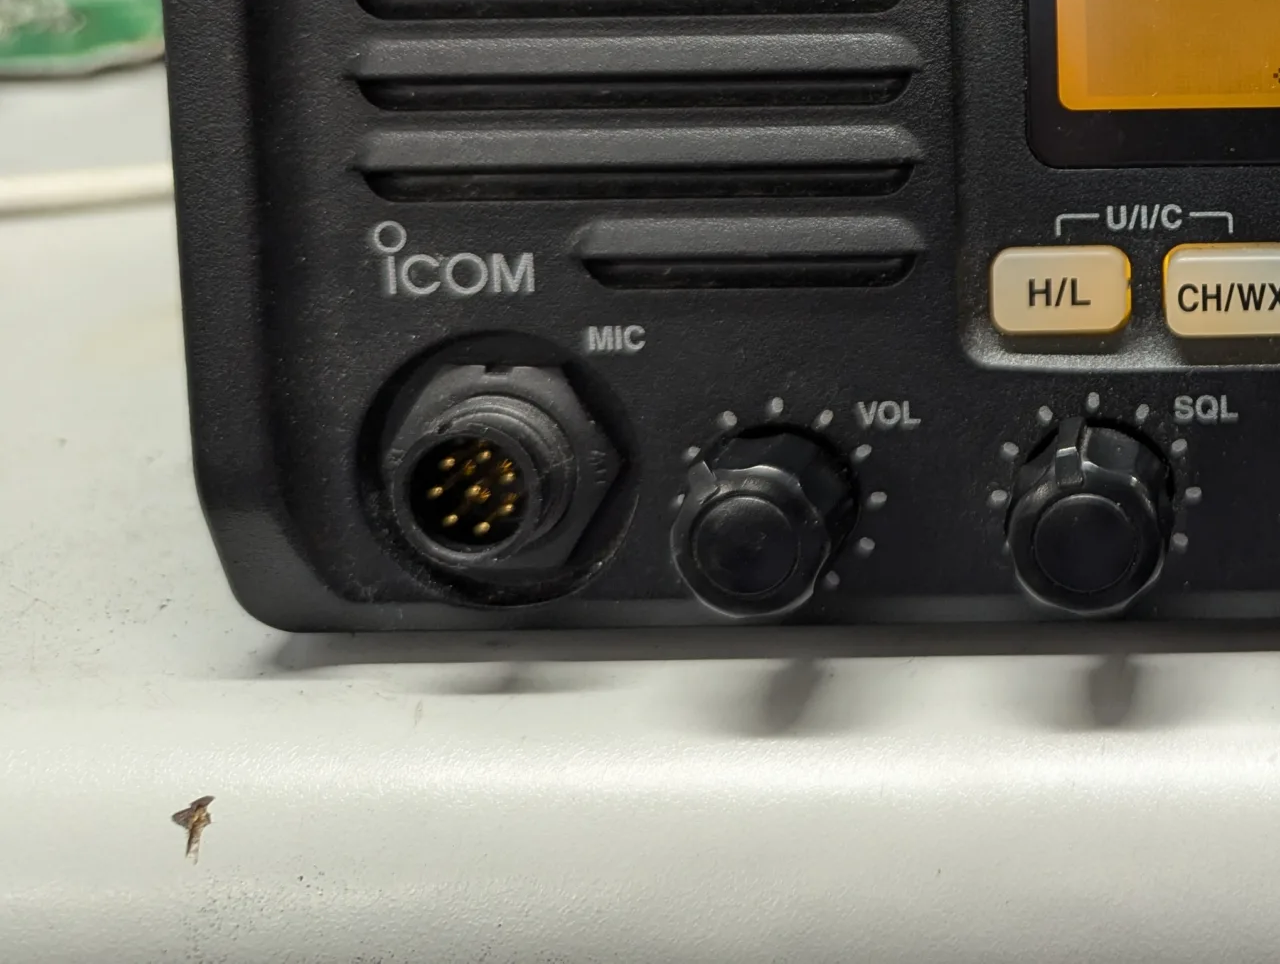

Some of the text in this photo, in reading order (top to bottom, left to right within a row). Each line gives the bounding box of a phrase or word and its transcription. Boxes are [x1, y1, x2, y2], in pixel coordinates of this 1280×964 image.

[1106, 203, 1183, 231] U/I/C
[1028, 277, 1092, 308] H/L
[588, 324, 646, 352] MIC
[857, 399, 922, 427] VOL
[1173, 394, 1239, 422] SQL
